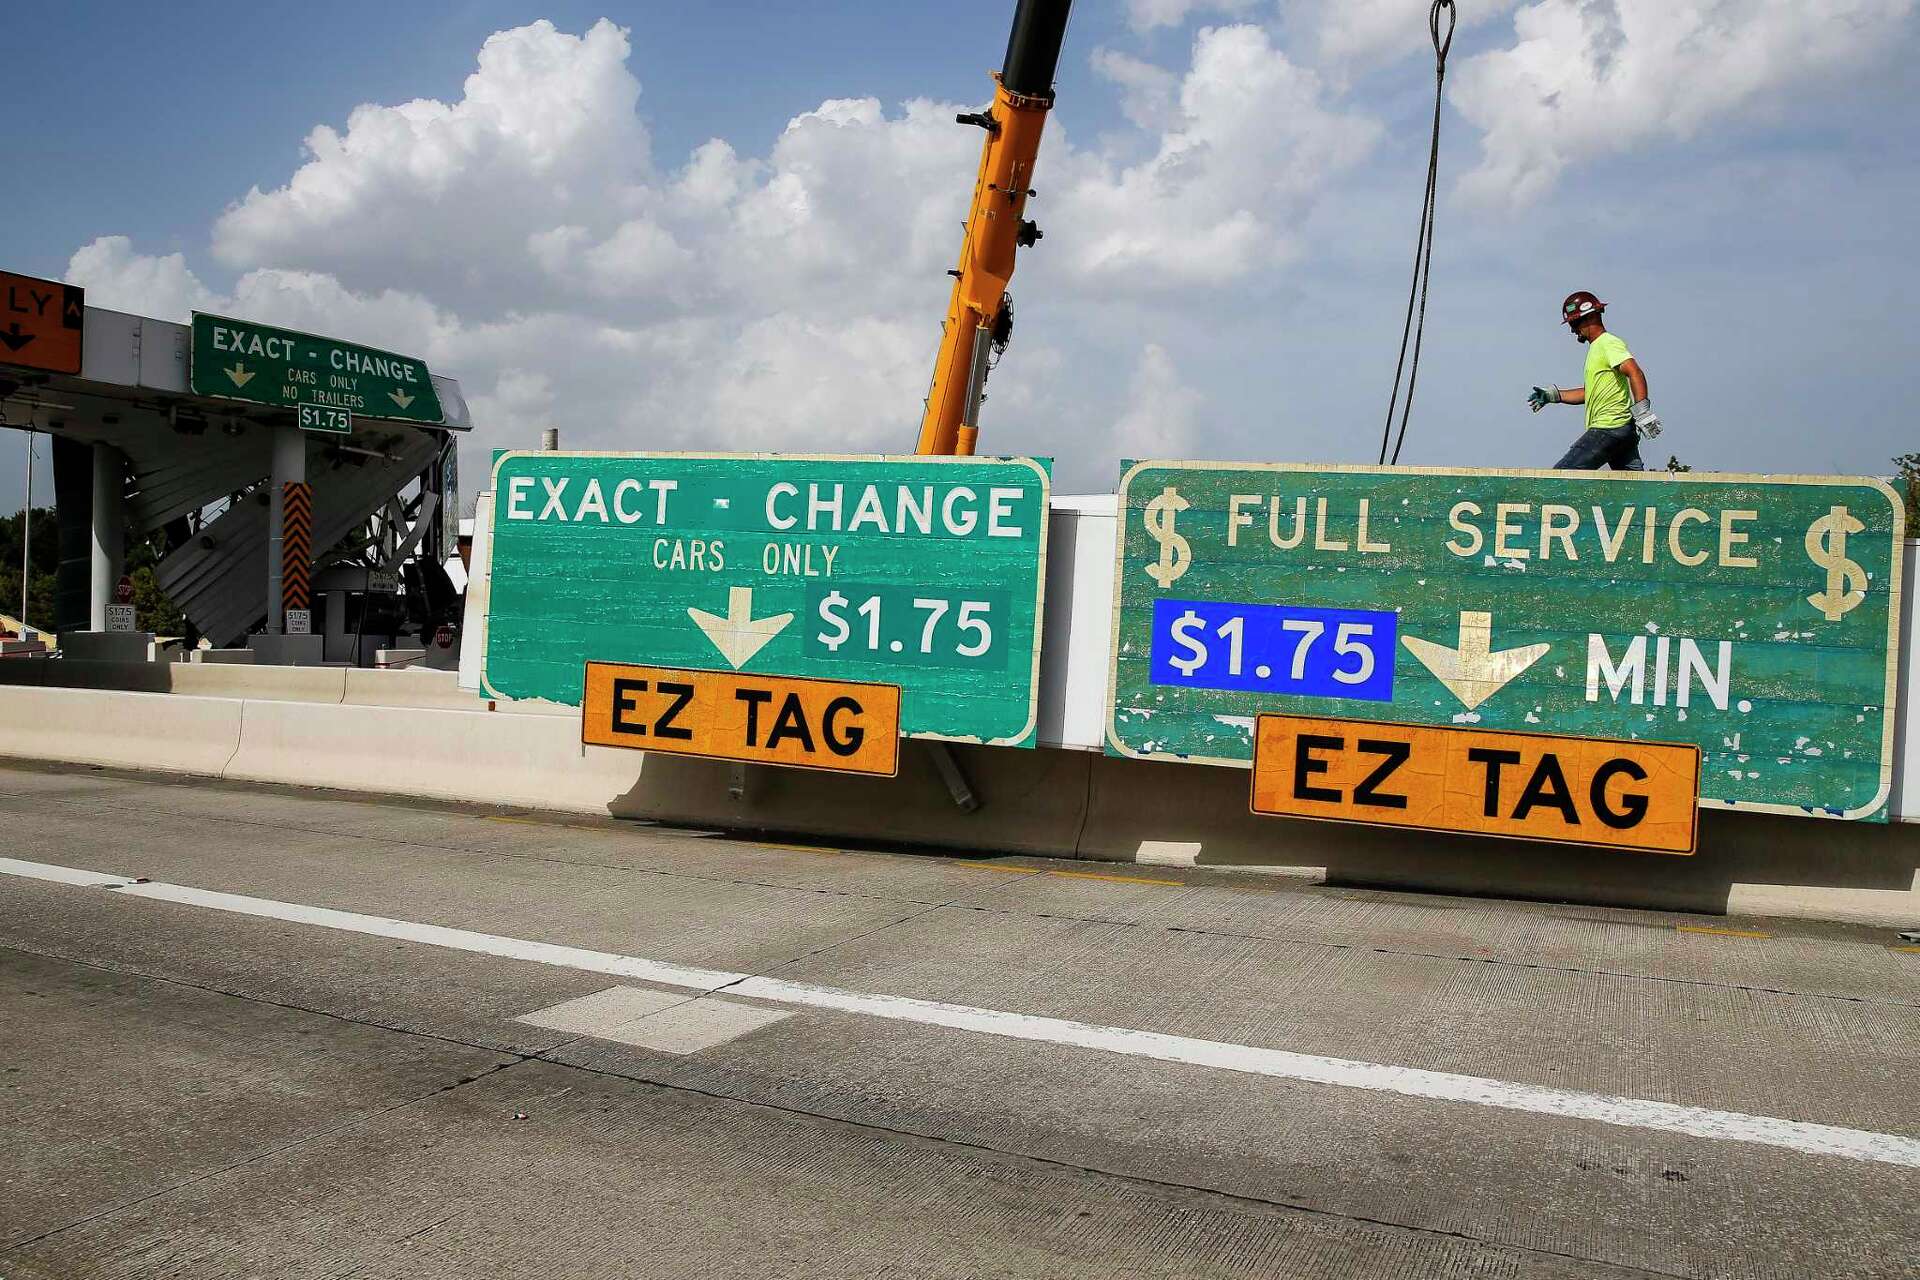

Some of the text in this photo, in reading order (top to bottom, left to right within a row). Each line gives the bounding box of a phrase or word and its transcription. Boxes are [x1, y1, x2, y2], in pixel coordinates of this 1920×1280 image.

[213, 326, 295, 361] EXACT
[330, 349, 417, 383] CHANGE
[288, 368, 358, 390] CARS ONLY
[282, 385, 365, 408] NO TRAILERS
[301, 407, 348, 428] $1.75
[507, 477, 678, 525] EXACT
[765, 482, 1024, 537] CHANGE
[1227, 494, 1391, 553] FULL
[1445, 501, 1759, 568] SERVICE
[652, 538, 840, 577] CARS ONLY
[817, 590, 992, 657] $1.75
[1168, 610, 1375, 685] $1.75
[1585, 633, 1752, 713] MIN.
[611, 678, 865, 757] EZ TAG
[1293, 733, 1649, 830] EZ TAG
